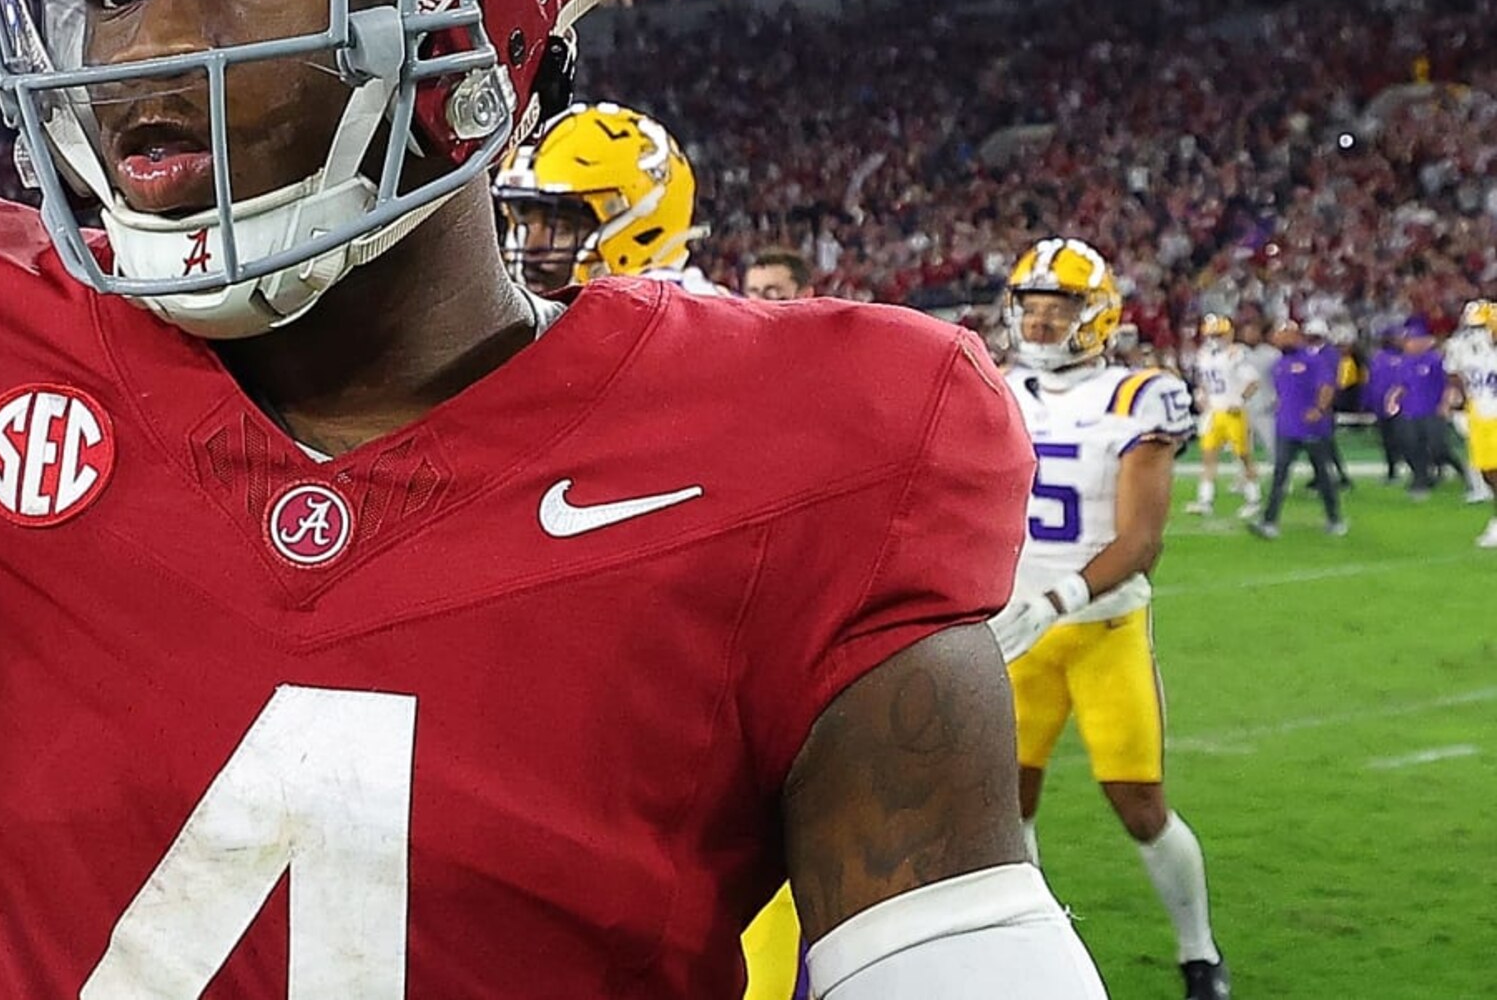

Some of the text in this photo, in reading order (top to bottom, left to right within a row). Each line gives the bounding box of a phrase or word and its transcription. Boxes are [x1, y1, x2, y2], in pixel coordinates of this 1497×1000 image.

[182, 225, 212, 277] A
[280, 496, 333, 546] A
[78, 683, 417, 1000] 4
